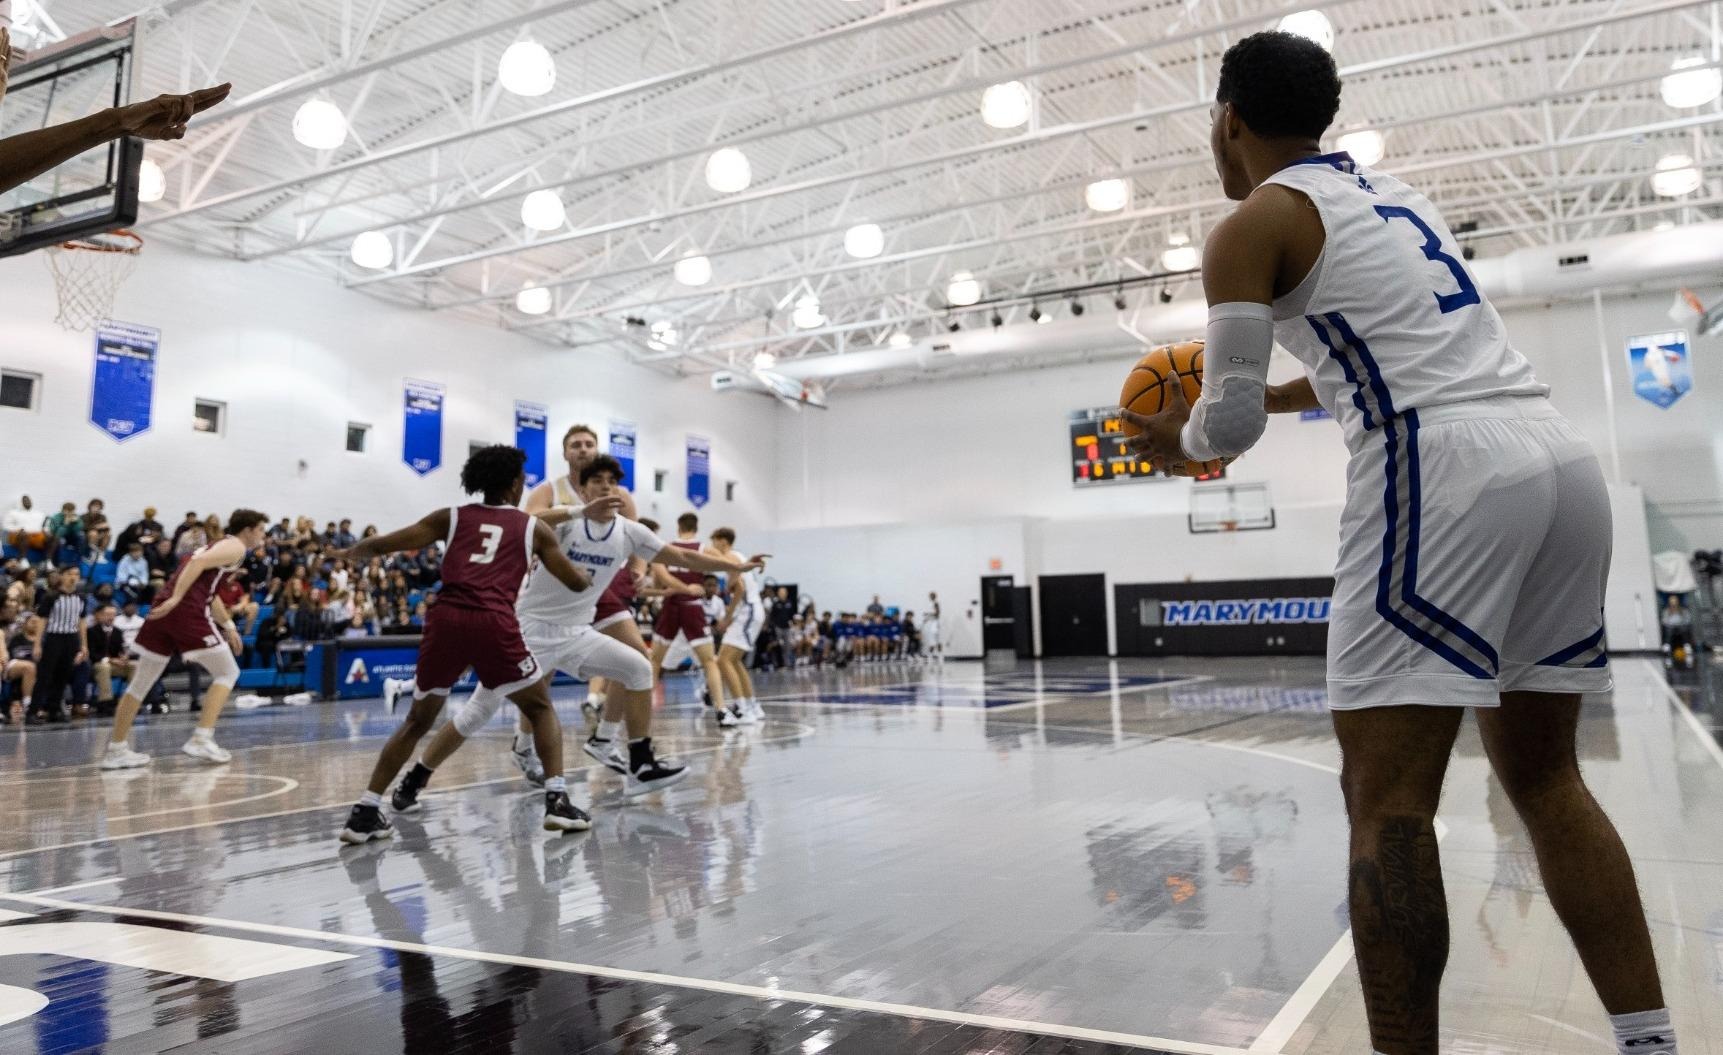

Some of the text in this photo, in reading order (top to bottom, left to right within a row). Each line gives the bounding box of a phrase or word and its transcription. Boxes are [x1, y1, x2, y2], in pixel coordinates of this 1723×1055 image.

[1373, 204, 1481, 314] 3
[469, 524, 503, 564] 3
[567, 548, 615, 567] MARYMOUNT
